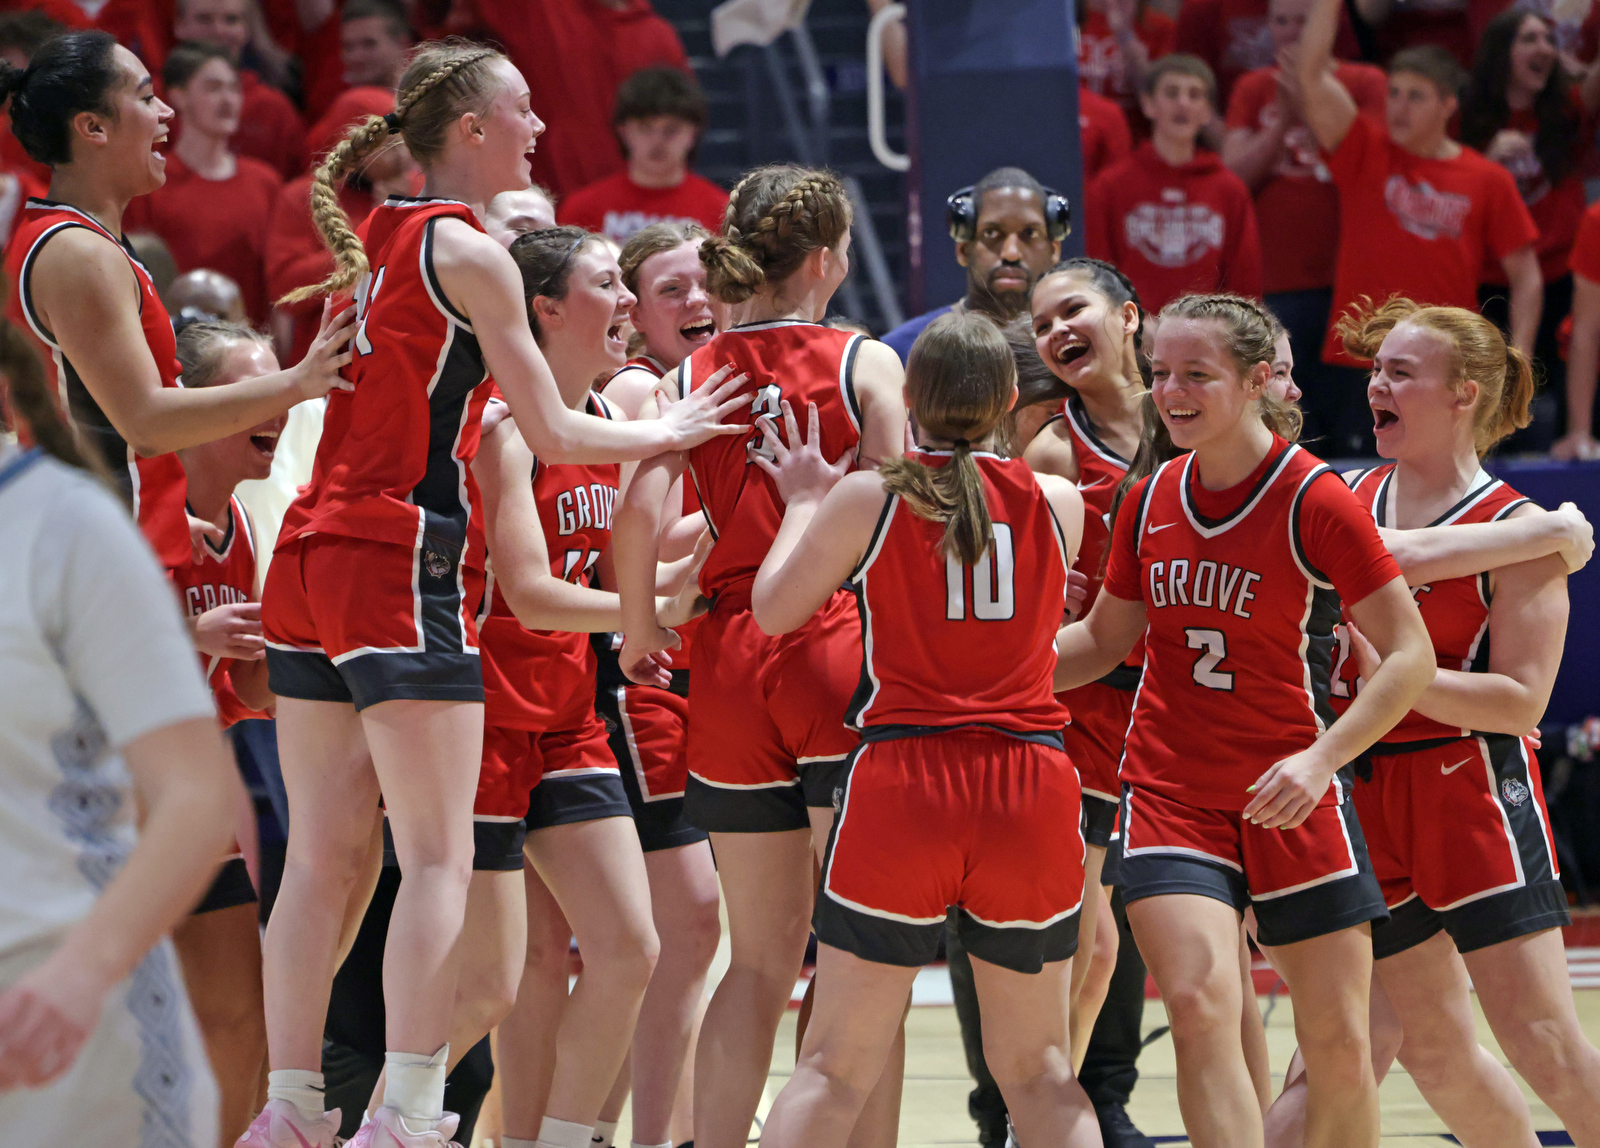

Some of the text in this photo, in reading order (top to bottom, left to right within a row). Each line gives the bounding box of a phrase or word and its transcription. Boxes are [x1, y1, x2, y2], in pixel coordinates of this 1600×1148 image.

[746, 383, 783, 465] 3
[556, 483, 619, 536] GROV
[944, 521, 1016, 621] 10
[1149, 558, 1262, 619] GROVE
[1182, 626, 1235, 692] 2
